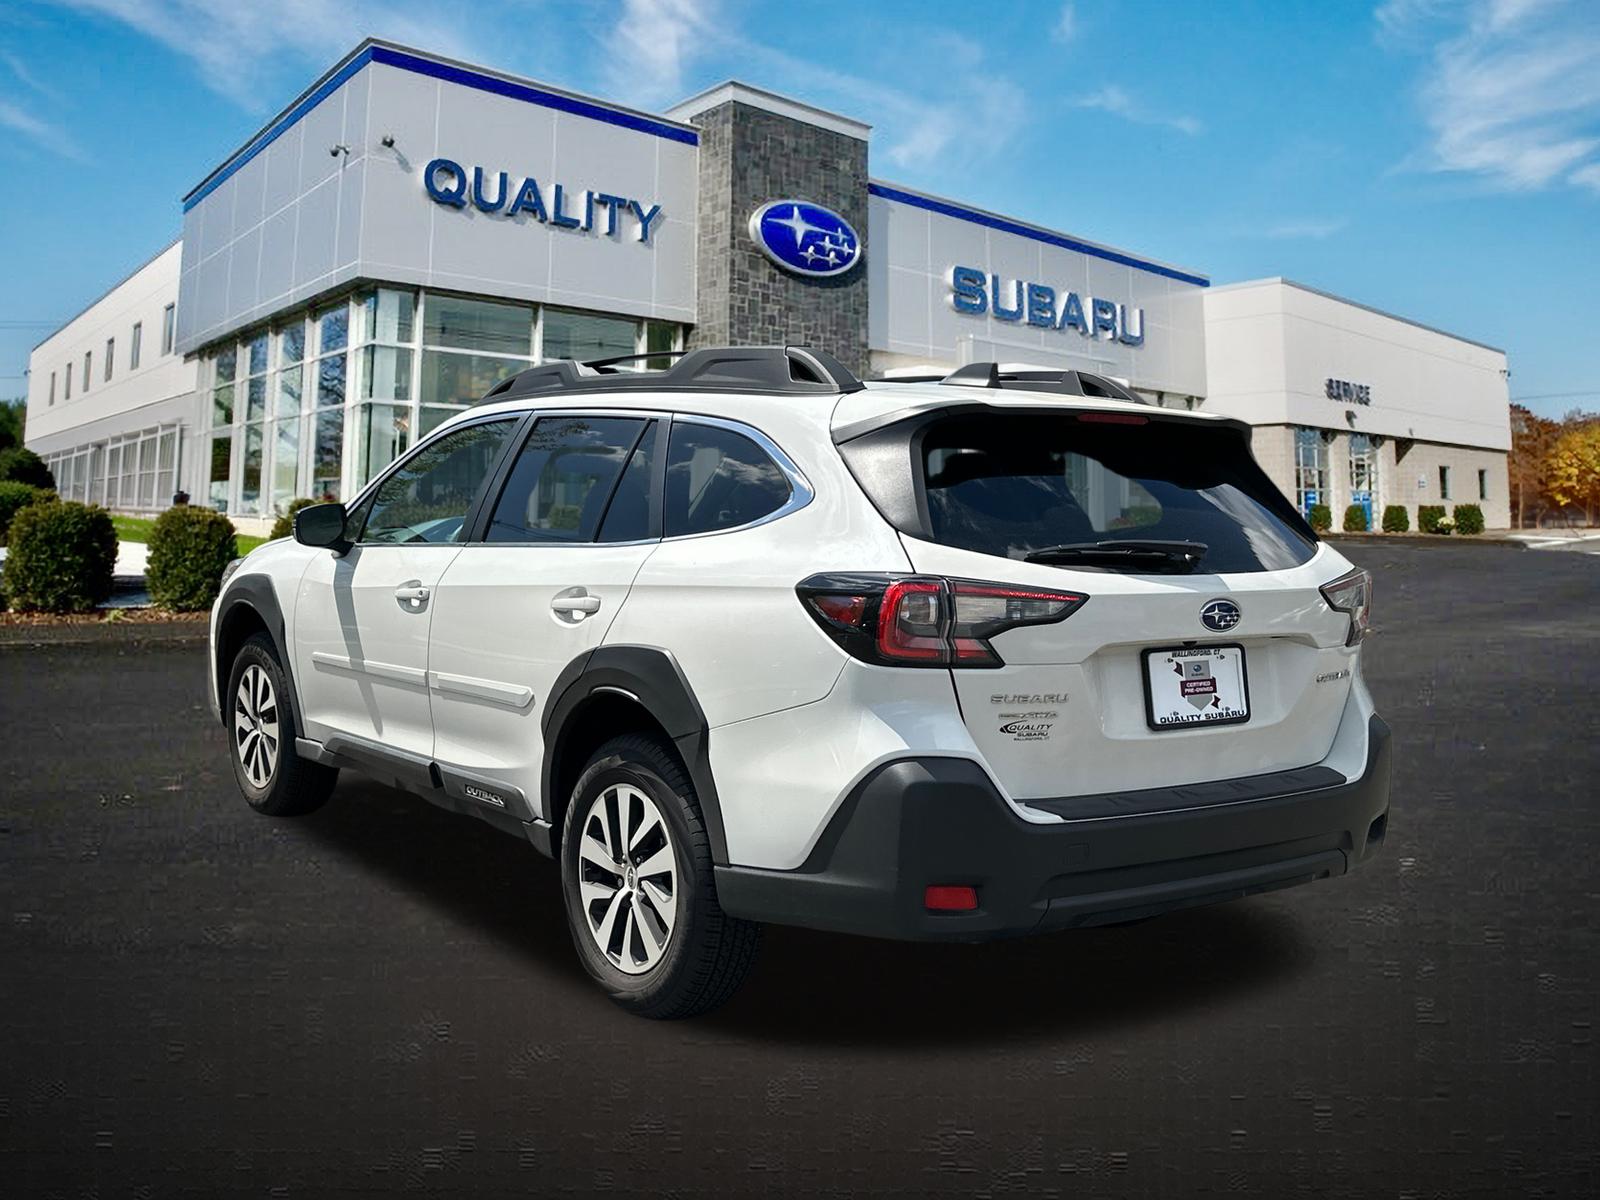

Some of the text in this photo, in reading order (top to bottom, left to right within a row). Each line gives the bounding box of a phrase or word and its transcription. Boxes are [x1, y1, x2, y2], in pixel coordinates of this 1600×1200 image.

[424, 158, 661, 242] QUALITY
[952, 265, 1145, 346] SUBARU
[991, 694, 1069, 704] SUBARU
[1160, 710, 1245, 724] QUALITY SUBARU
